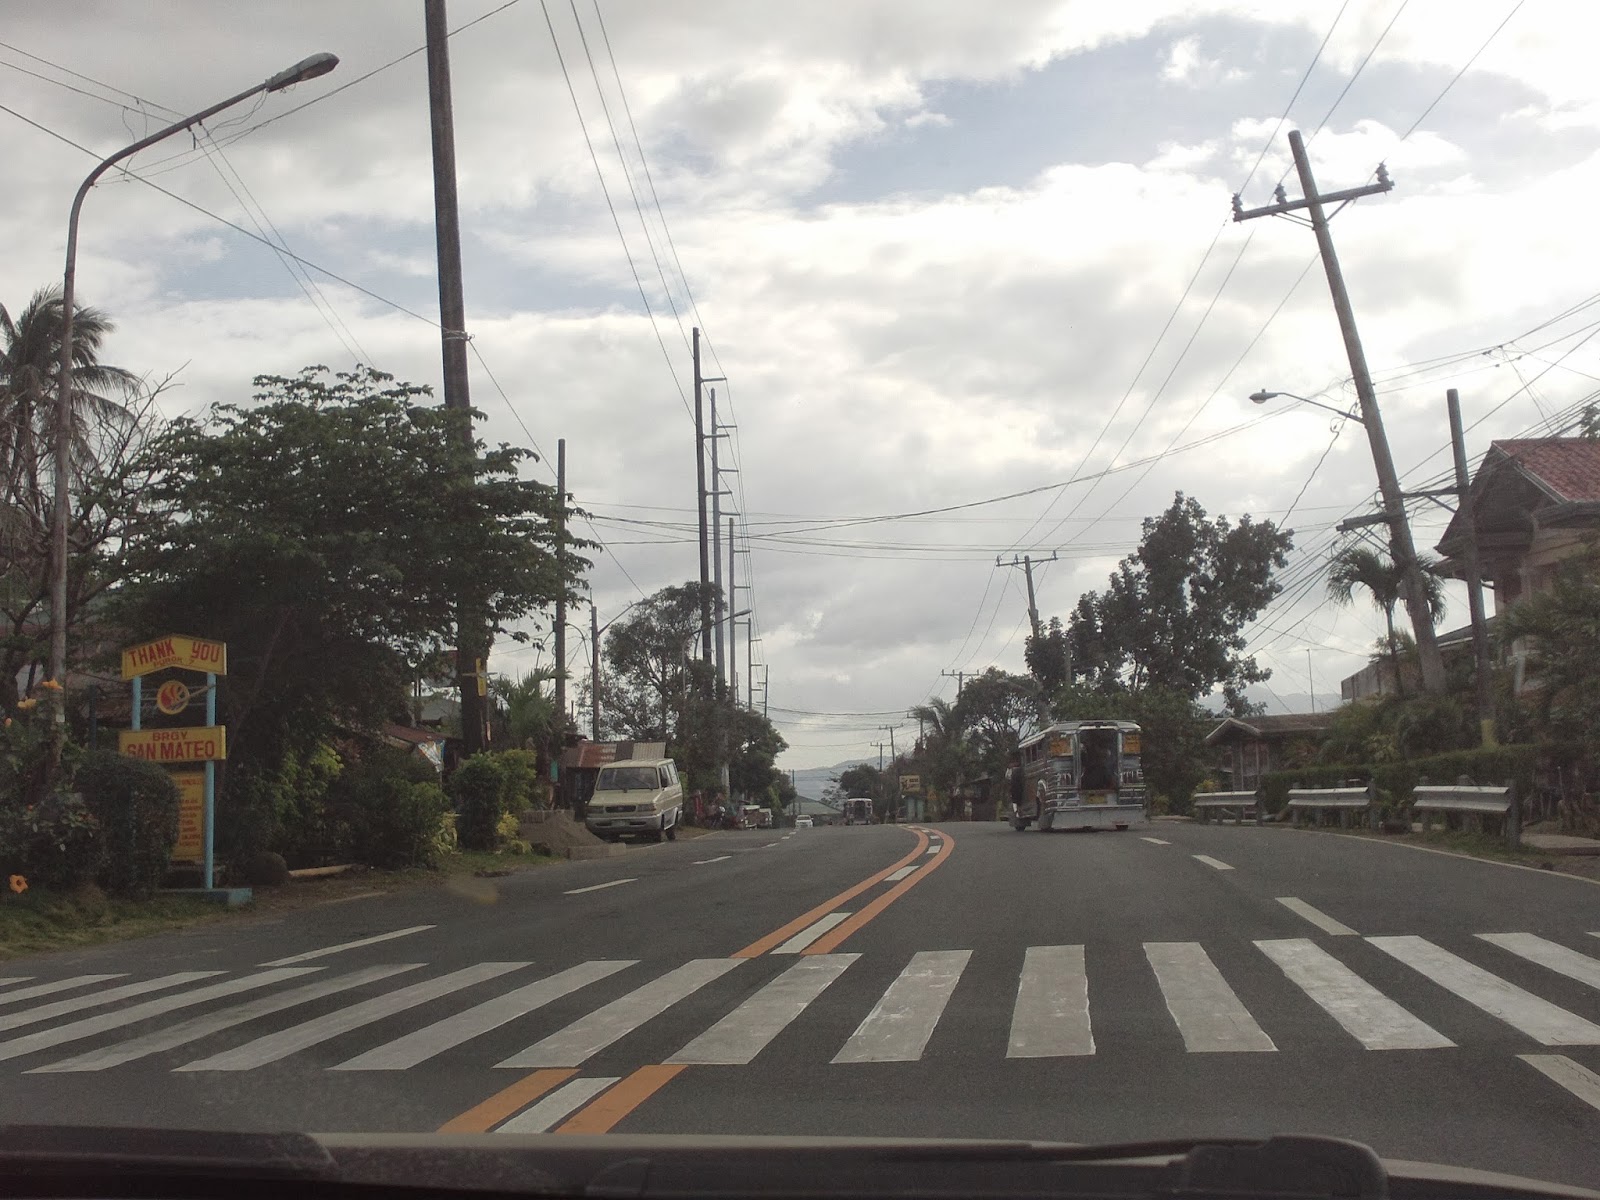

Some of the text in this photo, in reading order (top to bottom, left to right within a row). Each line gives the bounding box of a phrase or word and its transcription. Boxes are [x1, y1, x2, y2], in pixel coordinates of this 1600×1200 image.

[128, 639, 220, 667] THANK YOU
[152, 731, 188, 742] BRGY
[127, 740, 215, 760] SAN MATEO
